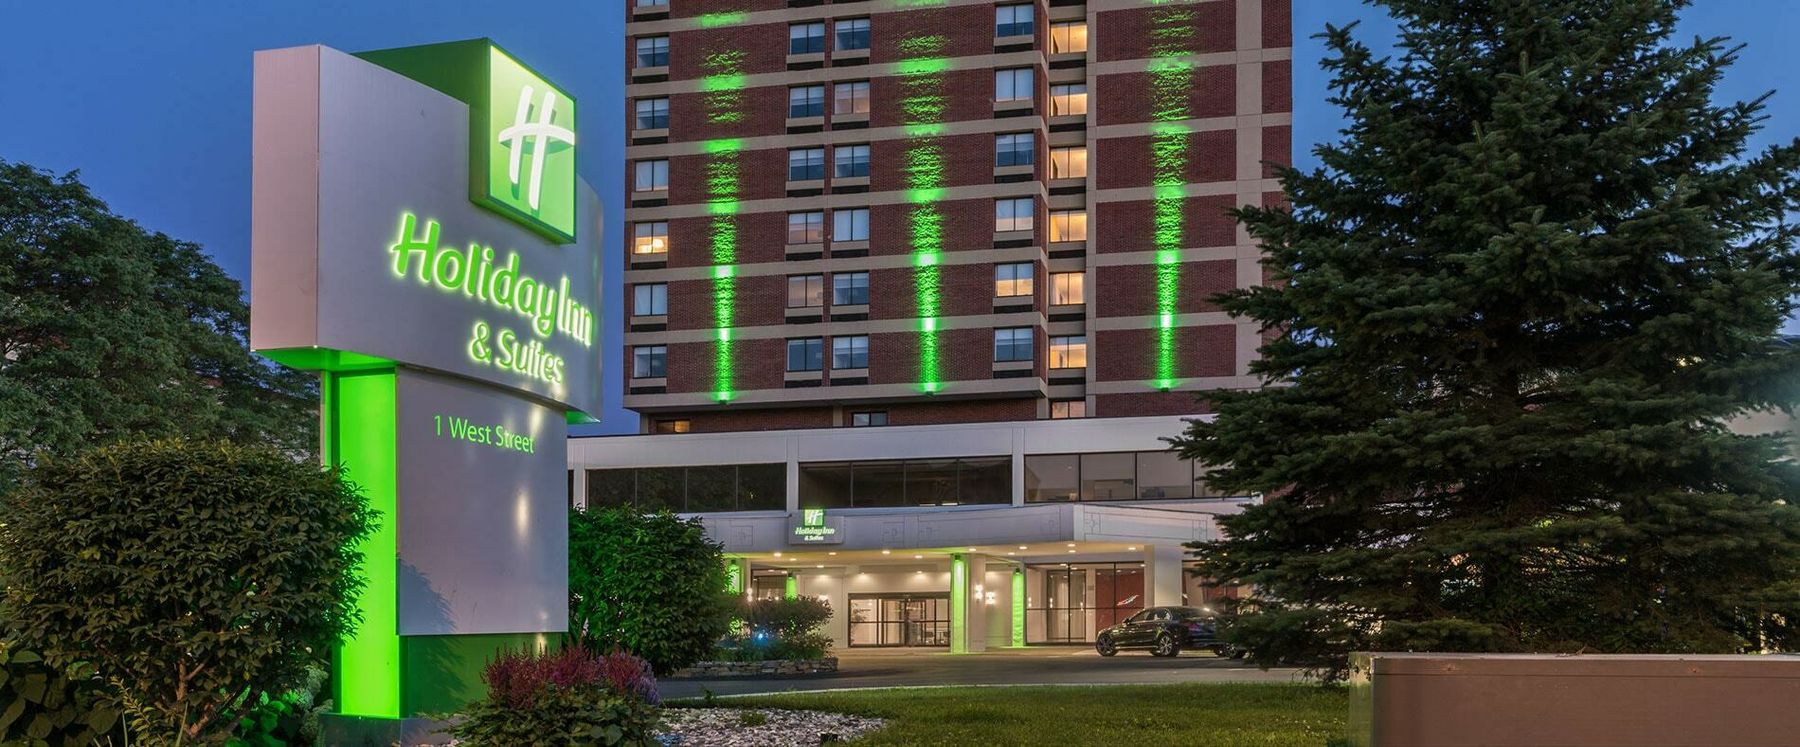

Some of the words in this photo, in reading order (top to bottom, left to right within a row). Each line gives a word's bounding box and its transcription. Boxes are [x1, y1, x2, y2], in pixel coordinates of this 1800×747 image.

[389, 212, 558, 338] Holiday
[557, 274, 594, 348] Inn
[468, 320, 492, 364] &
[495, 328, 565, 386] Suites
[434, 415, 441, 436] 1
[449, 416, 492, 445] West
[495, 425, 535, 454] Street
[795, 526, 823, 536] Holiday
[822, 526, 836, 535] Inn
